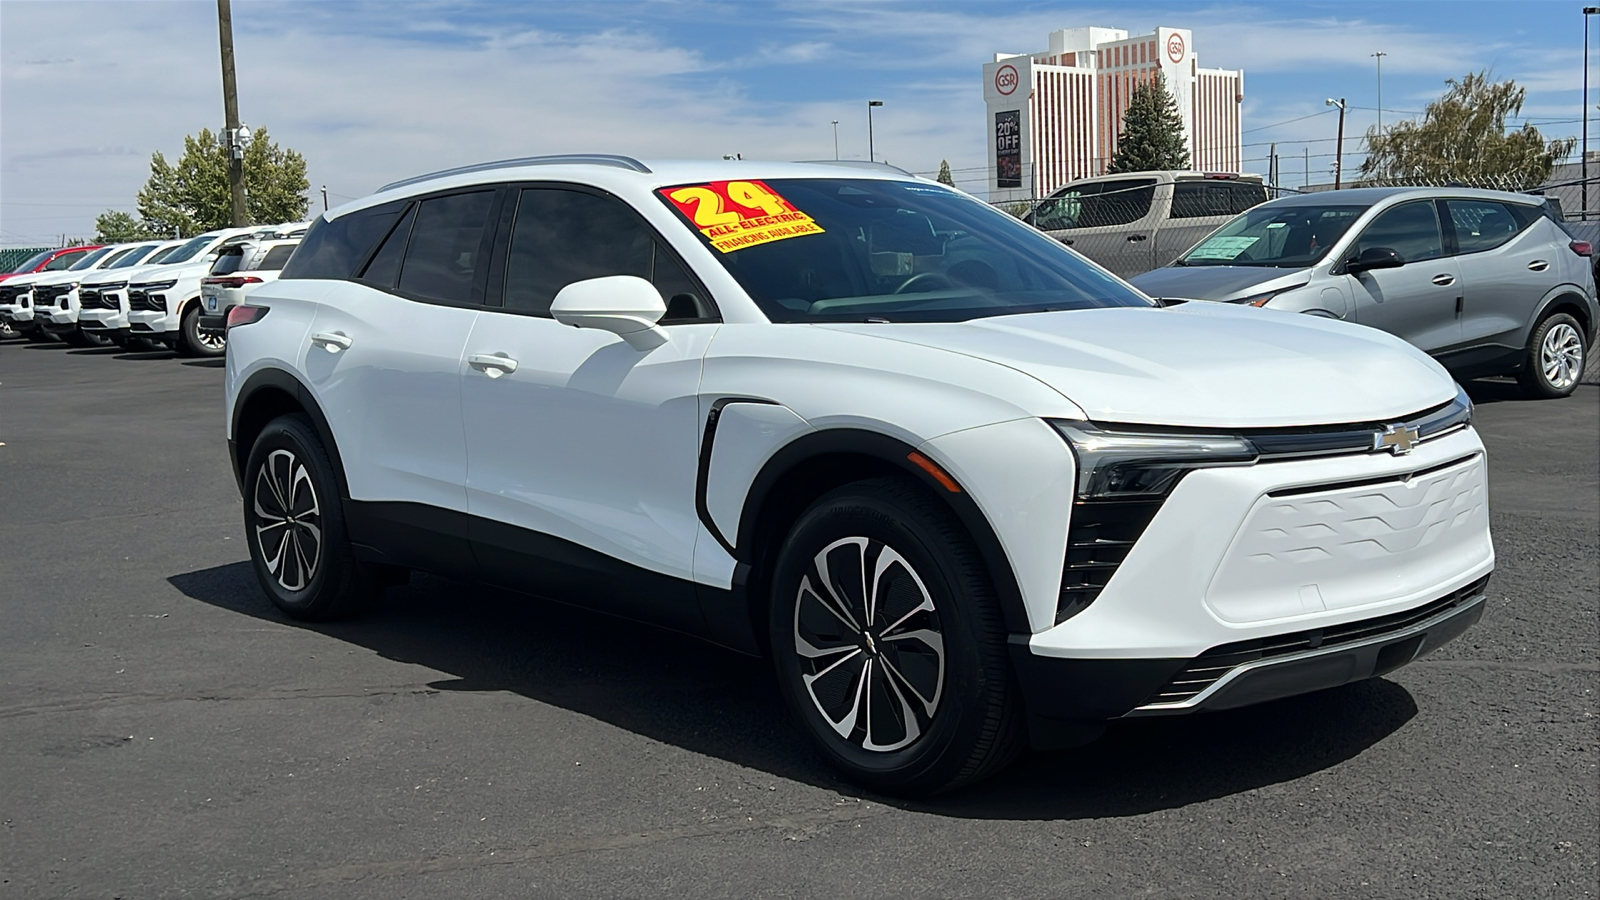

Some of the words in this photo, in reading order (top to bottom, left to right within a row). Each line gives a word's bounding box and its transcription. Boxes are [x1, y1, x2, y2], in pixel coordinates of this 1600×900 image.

[1169, 41, 1183, 57] GSR
[998, 73, 1016, 87] GSR
[997, 121, 1018, 136] 20%
[998, 135, 1019, 150] OFF
[669, 181, 788, 227] 24
[715, 231, 770, 251] FINANCING
[769, 223, 819, 241] AVAILABLE
